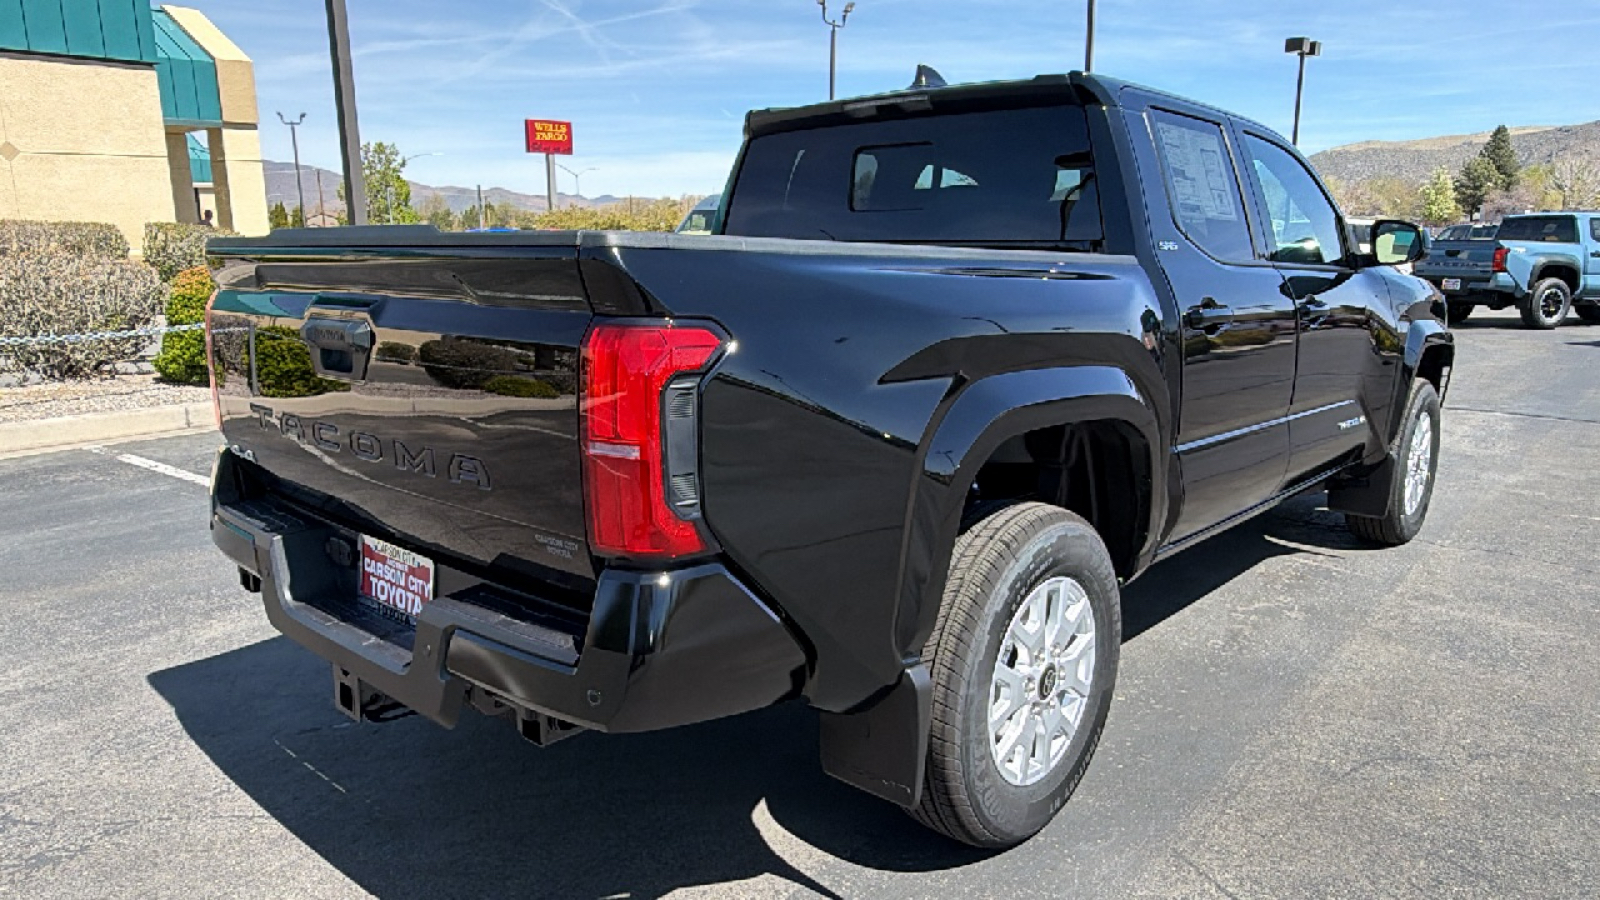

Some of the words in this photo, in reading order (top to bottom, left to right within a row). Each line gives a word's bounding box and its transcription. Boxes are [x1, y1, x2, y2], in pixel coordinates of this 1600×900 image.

[534, 122, 567, 133] WELLS
[535, 132, 568, 142] FARGO
[249, 402, 492, 490] TACOMA
[376, 540, 402, 559] CARSON
[402, 550, 416, 565] CITY
[364, 557, 405, 587] CARSON
[408, 574, 431, 598] CITY
[369, 575, 422, 615] TOYOTA
[378, 603, 411, 625] TOYOTA
